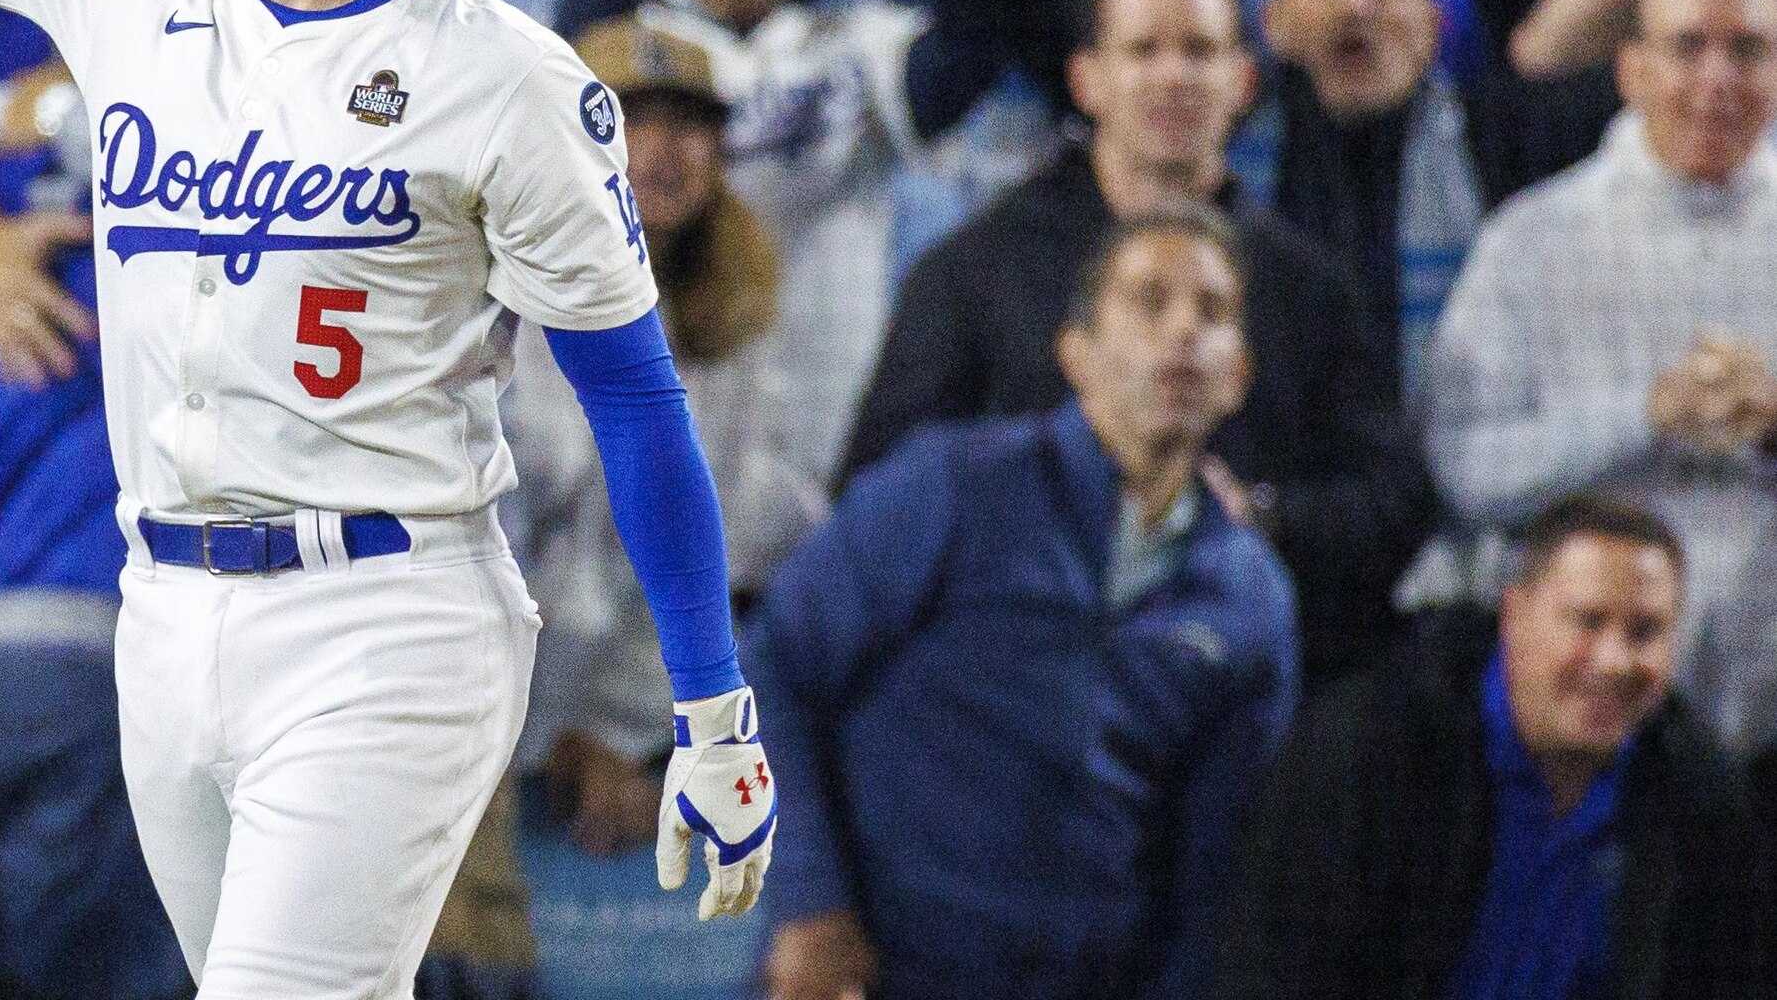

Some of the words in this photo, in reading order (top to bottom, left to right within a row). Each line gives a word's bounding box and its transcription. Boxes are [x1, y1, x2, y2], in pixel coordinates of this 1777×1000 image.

[353, 98, 400, 116] SERIES
[355, 88, 404, 106] WORLD
[591, 98, 614, 137] 34
[100, 102, 421, 286] Dodgers
[293, 284, 369, 400] 5
